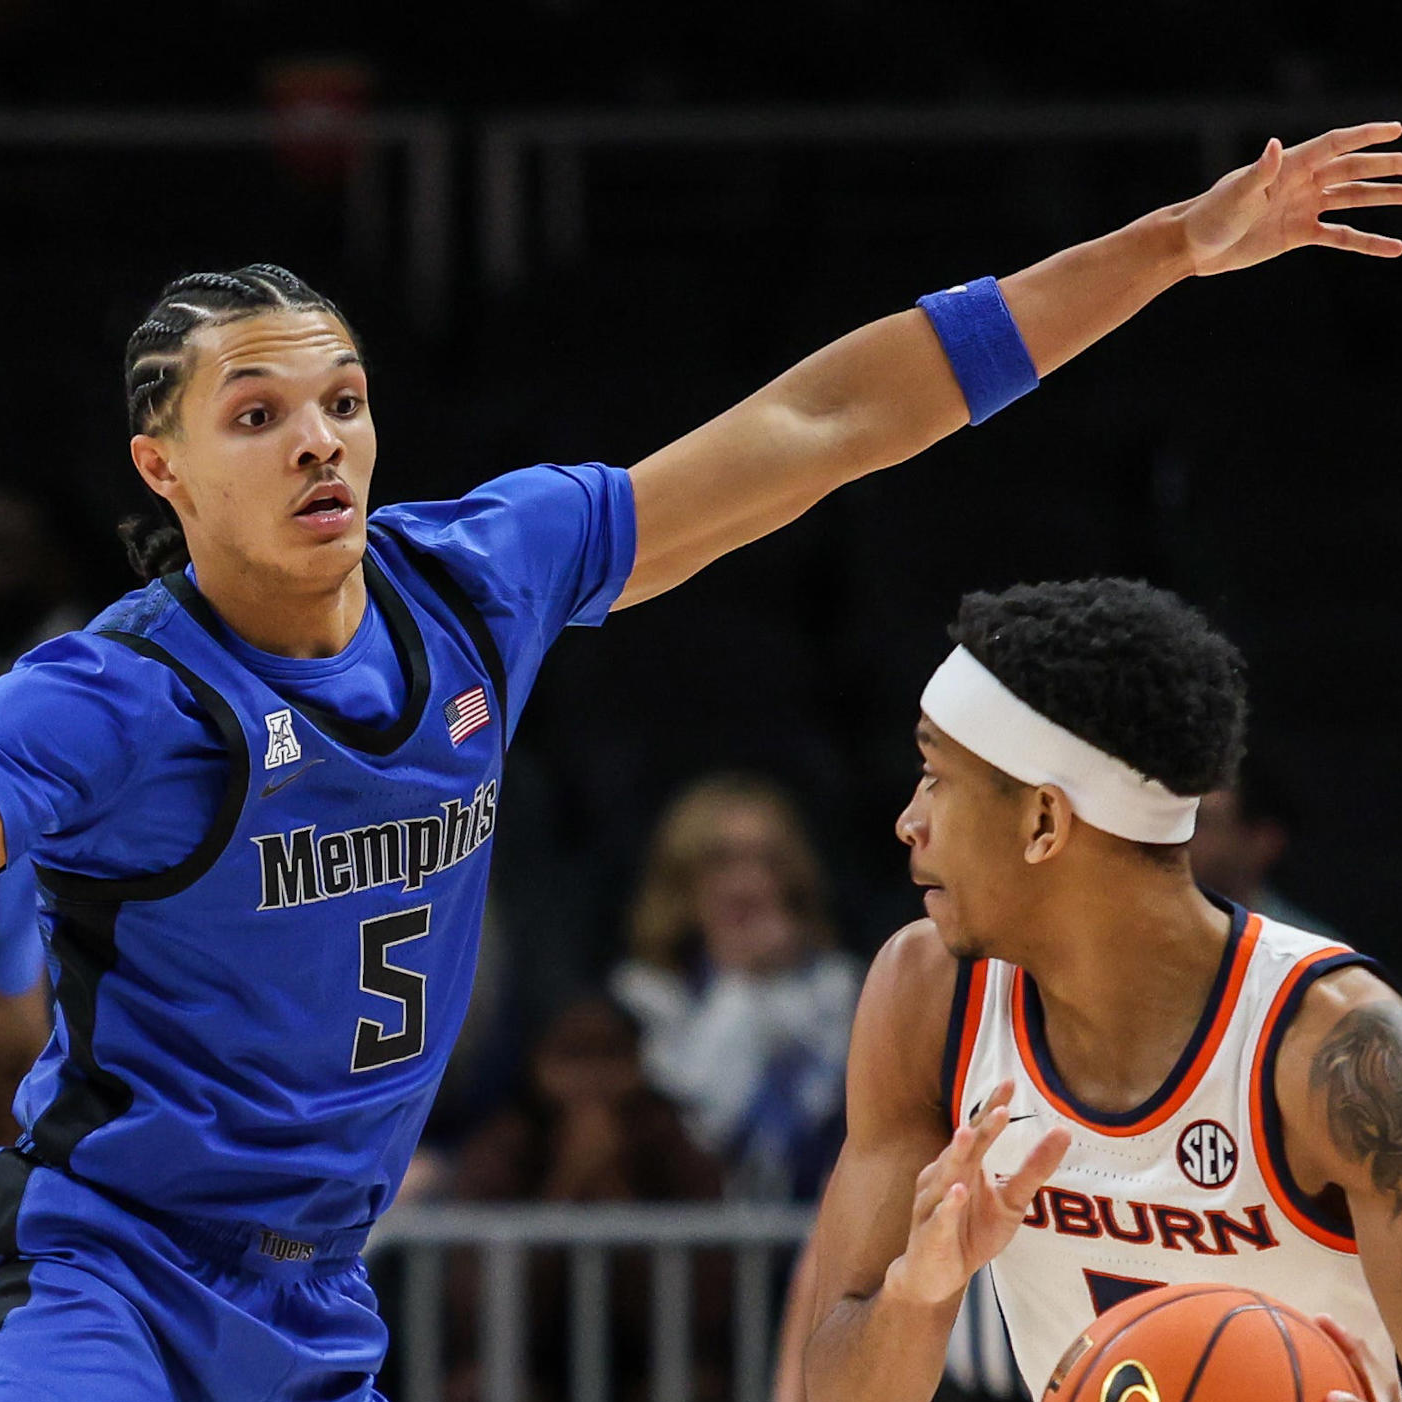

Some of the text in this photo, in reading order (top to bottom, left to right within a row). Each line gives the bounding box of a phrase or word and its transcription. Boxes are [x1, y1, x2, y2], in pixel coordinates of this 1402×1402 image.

[250, 779, 497, 912] Memphis
[350, 903, 432, 1074] 5
[1179, 1122, 1236, 1187] SEC
[259, 1228, 315, 1262] Tigers
[1021, 1185, 1280, 1256] UBURN
